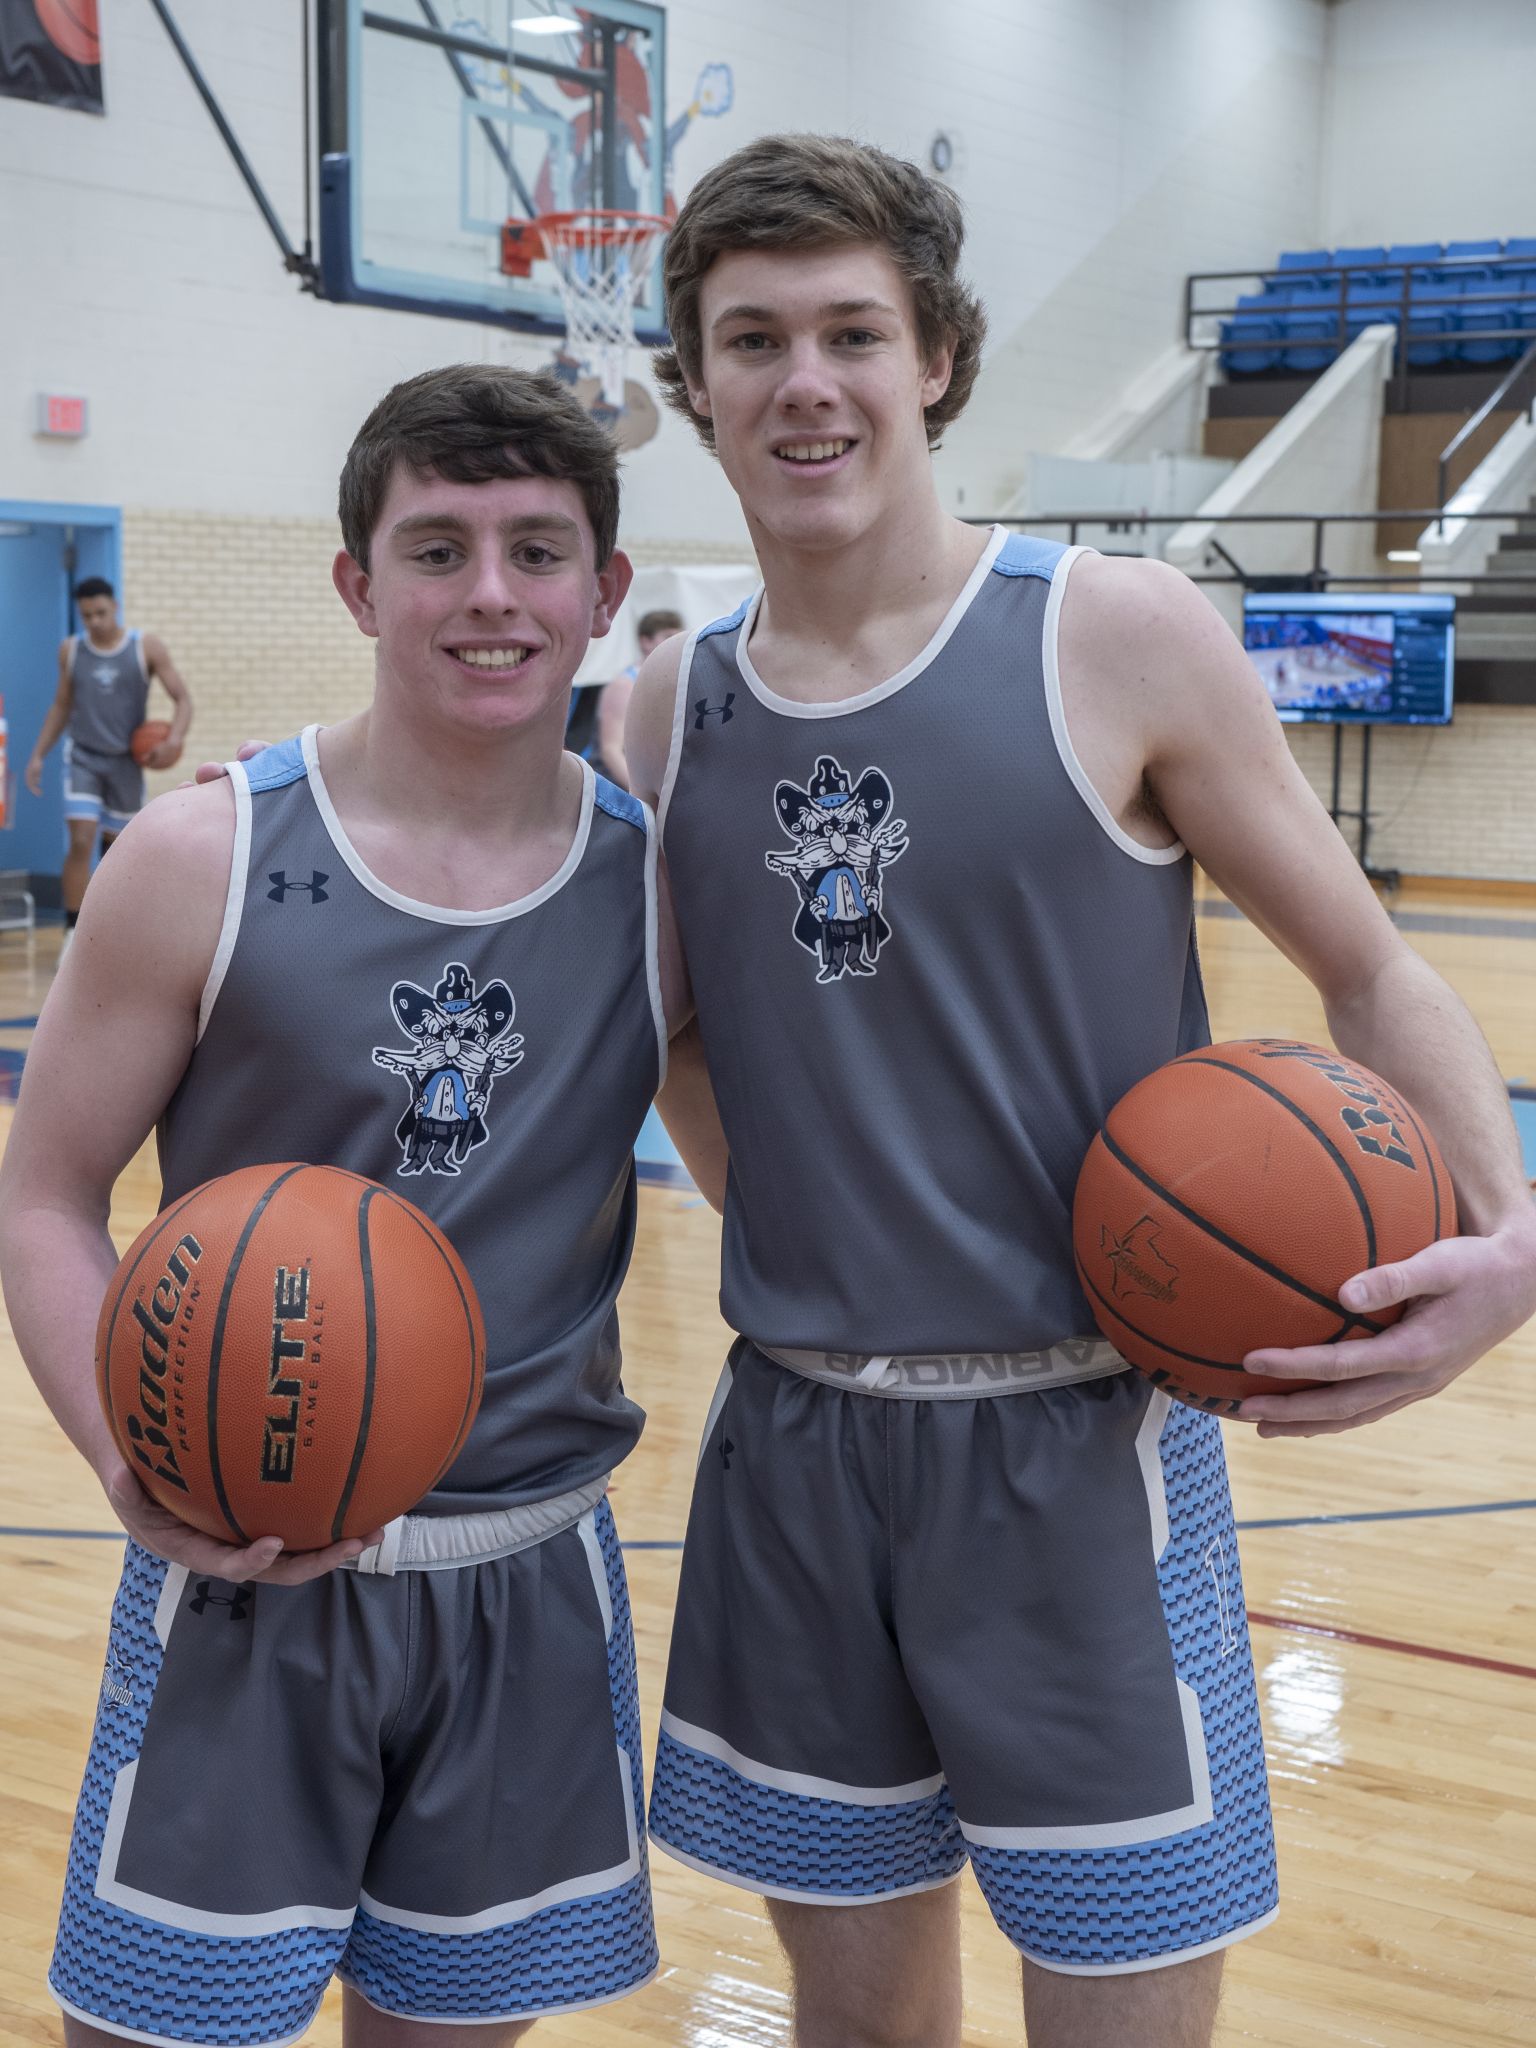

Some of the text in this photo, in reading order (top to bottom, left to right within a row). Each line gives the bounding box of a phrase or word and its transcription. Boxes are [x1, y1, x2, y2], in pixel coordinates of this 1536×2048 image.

[1257, 1039, 1418, 1173] Bad
[126, 1233, 203, 1494] Baden
[173, 1285, 201, 1452] PERFECTION
[260, 1266, 310, 1484] ELITE
[303, 1301, 325, 1448] GAME BALL
[825, 1341, 1098, 1386] ARMOR
[1205, 1535, 1238, 1658] 1
